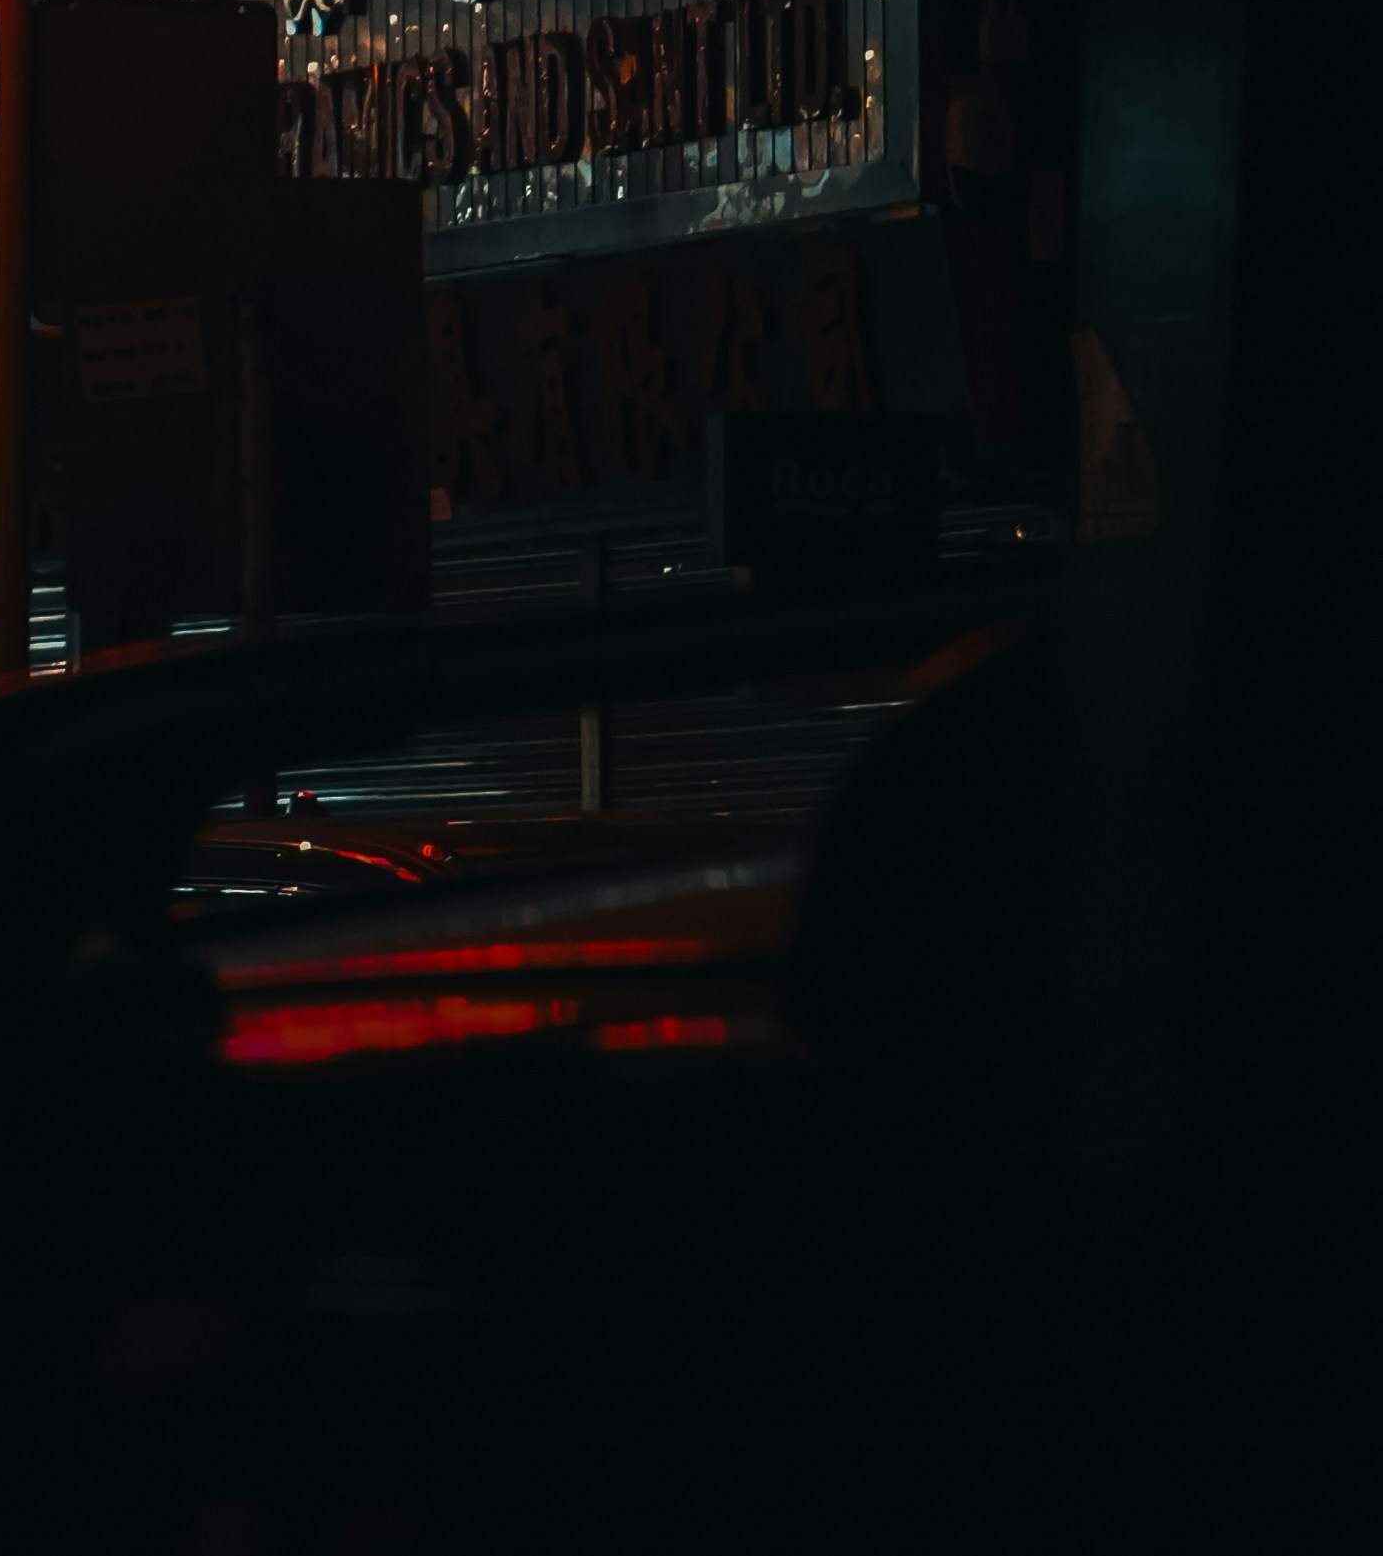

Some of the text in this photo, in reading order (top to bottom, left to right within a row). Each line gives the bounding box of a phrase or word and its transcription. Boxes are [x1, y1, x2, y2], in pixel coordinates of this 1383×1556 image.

[276, 45, 469, 186] RAMICS
[472, 29, 583, 175] AND
[772, 458, 894, 495] Roca
